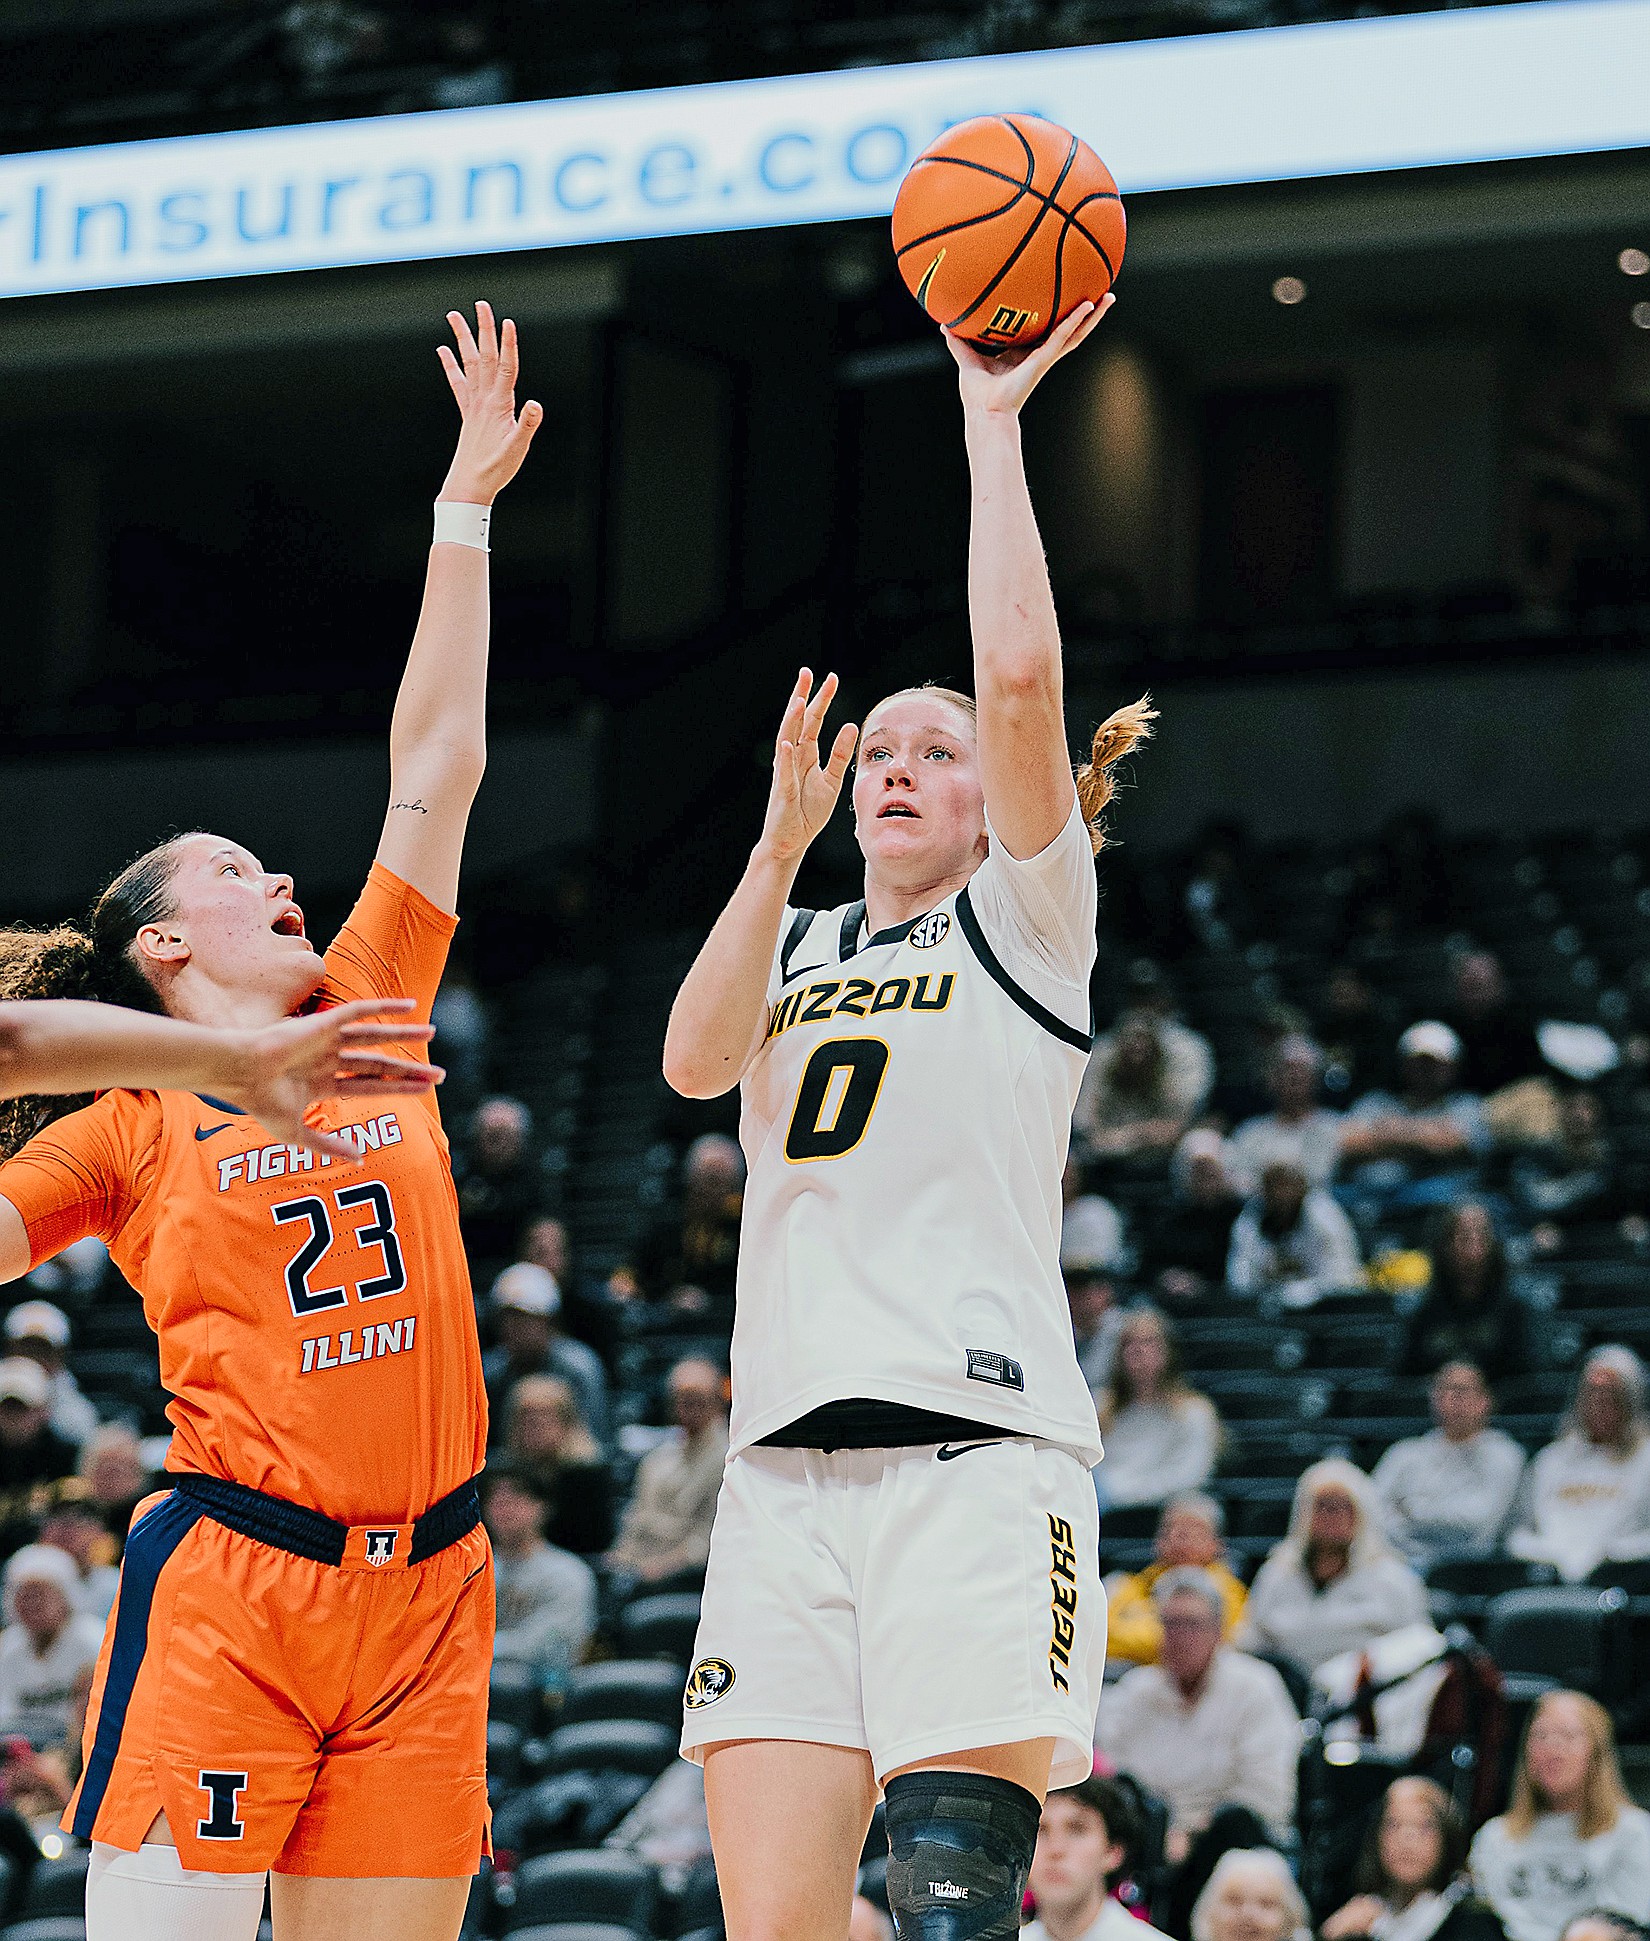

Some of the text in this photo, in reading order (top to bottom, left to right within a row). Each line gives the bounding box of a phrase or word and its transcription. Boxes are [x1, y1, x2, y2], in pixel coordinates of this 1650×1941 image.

[0, 108, 1043, 265] Insurance.co
[911, 914, 949, 948] SEC
[766, 972, 958, 1041] MIZZOU
[783, 1034, 892, 1166] 0
[270, 1179, 408, 1318] 23
[300, 1316, 417, 1373] ILLINI
[1007, 1364, 1016, 1379] L
[1046, 1511, 1080, 1697] TIGERS
[196, 1769, 249, 1841] I
